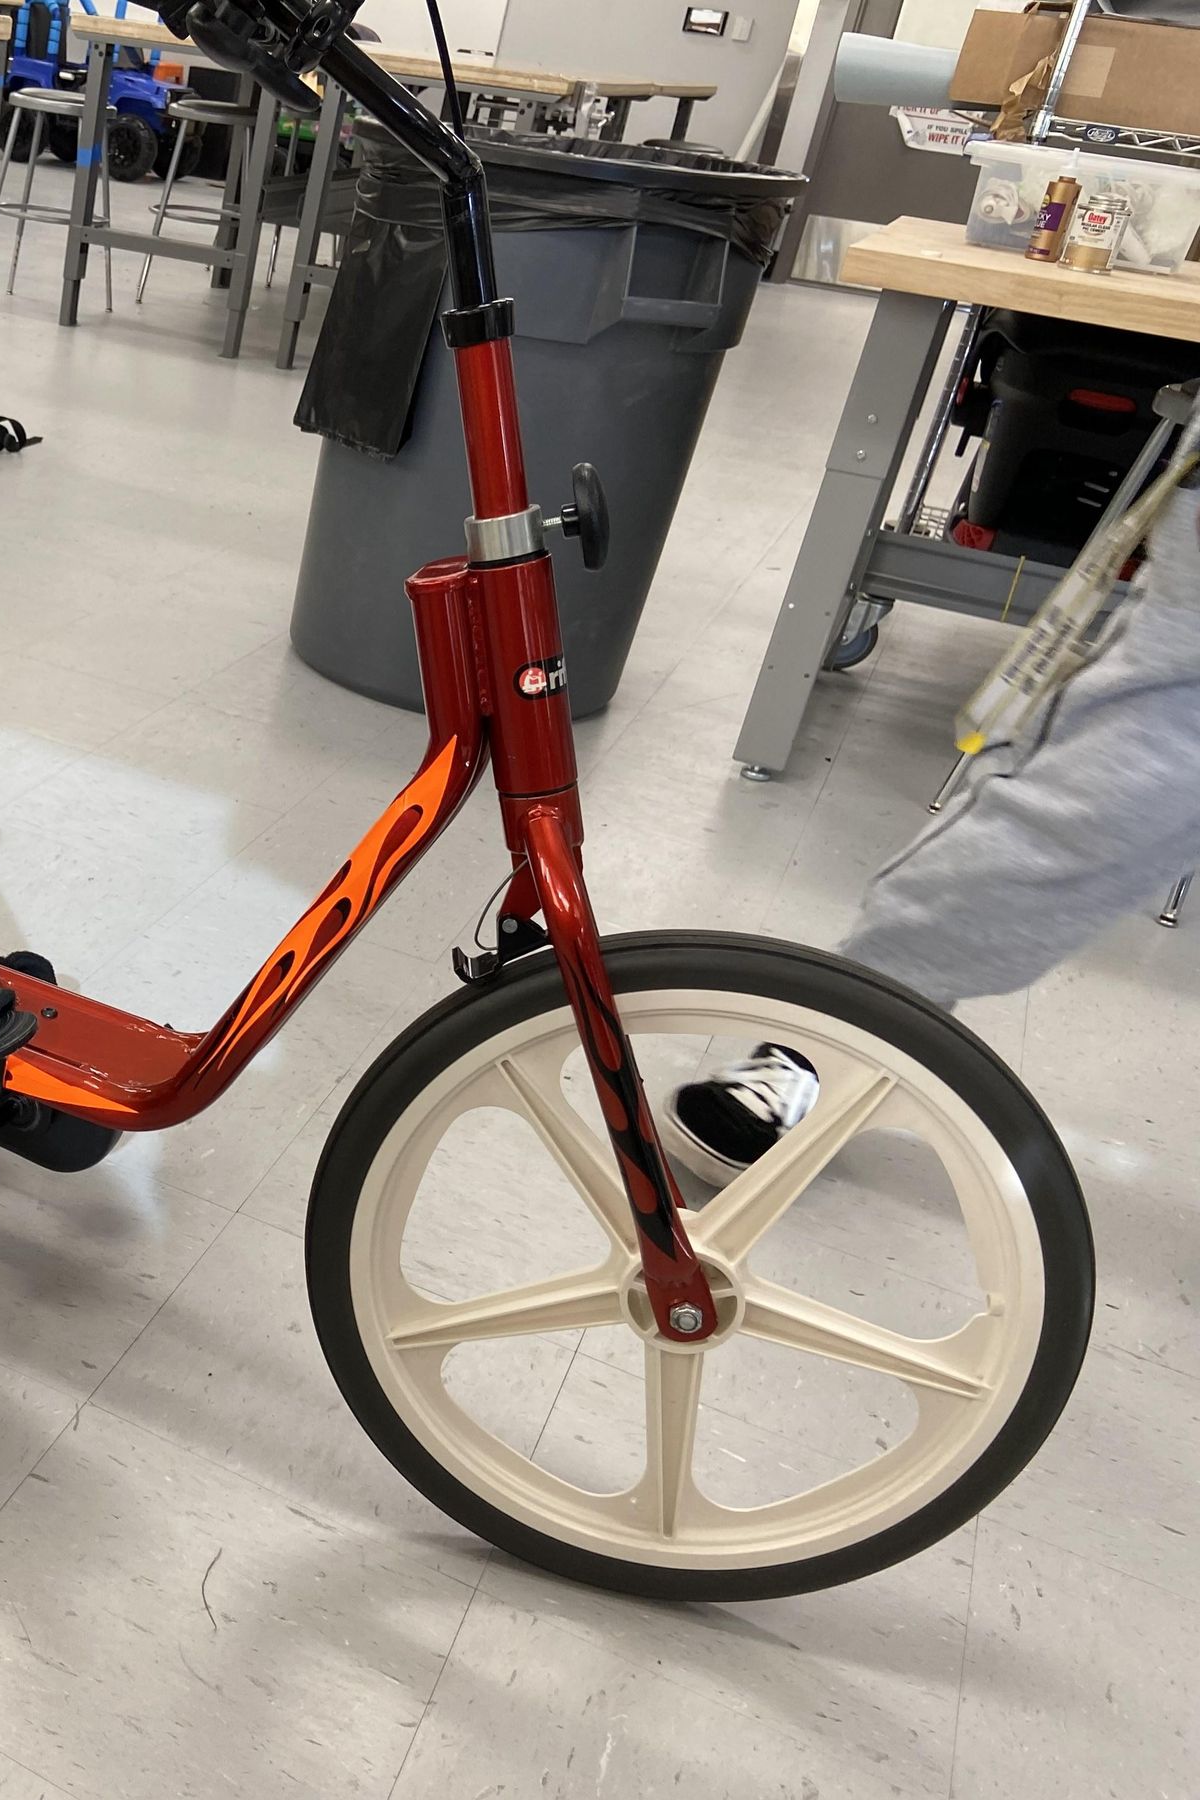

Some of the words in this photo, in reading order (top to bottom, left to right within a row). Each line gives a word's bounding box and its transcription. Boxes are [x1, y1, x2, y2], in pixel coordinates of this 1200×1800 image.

[928, 132, 949, 144] WIPE
[951, 134, 961, 145] IT
[1088, 212, 1108, 224] Oatey
